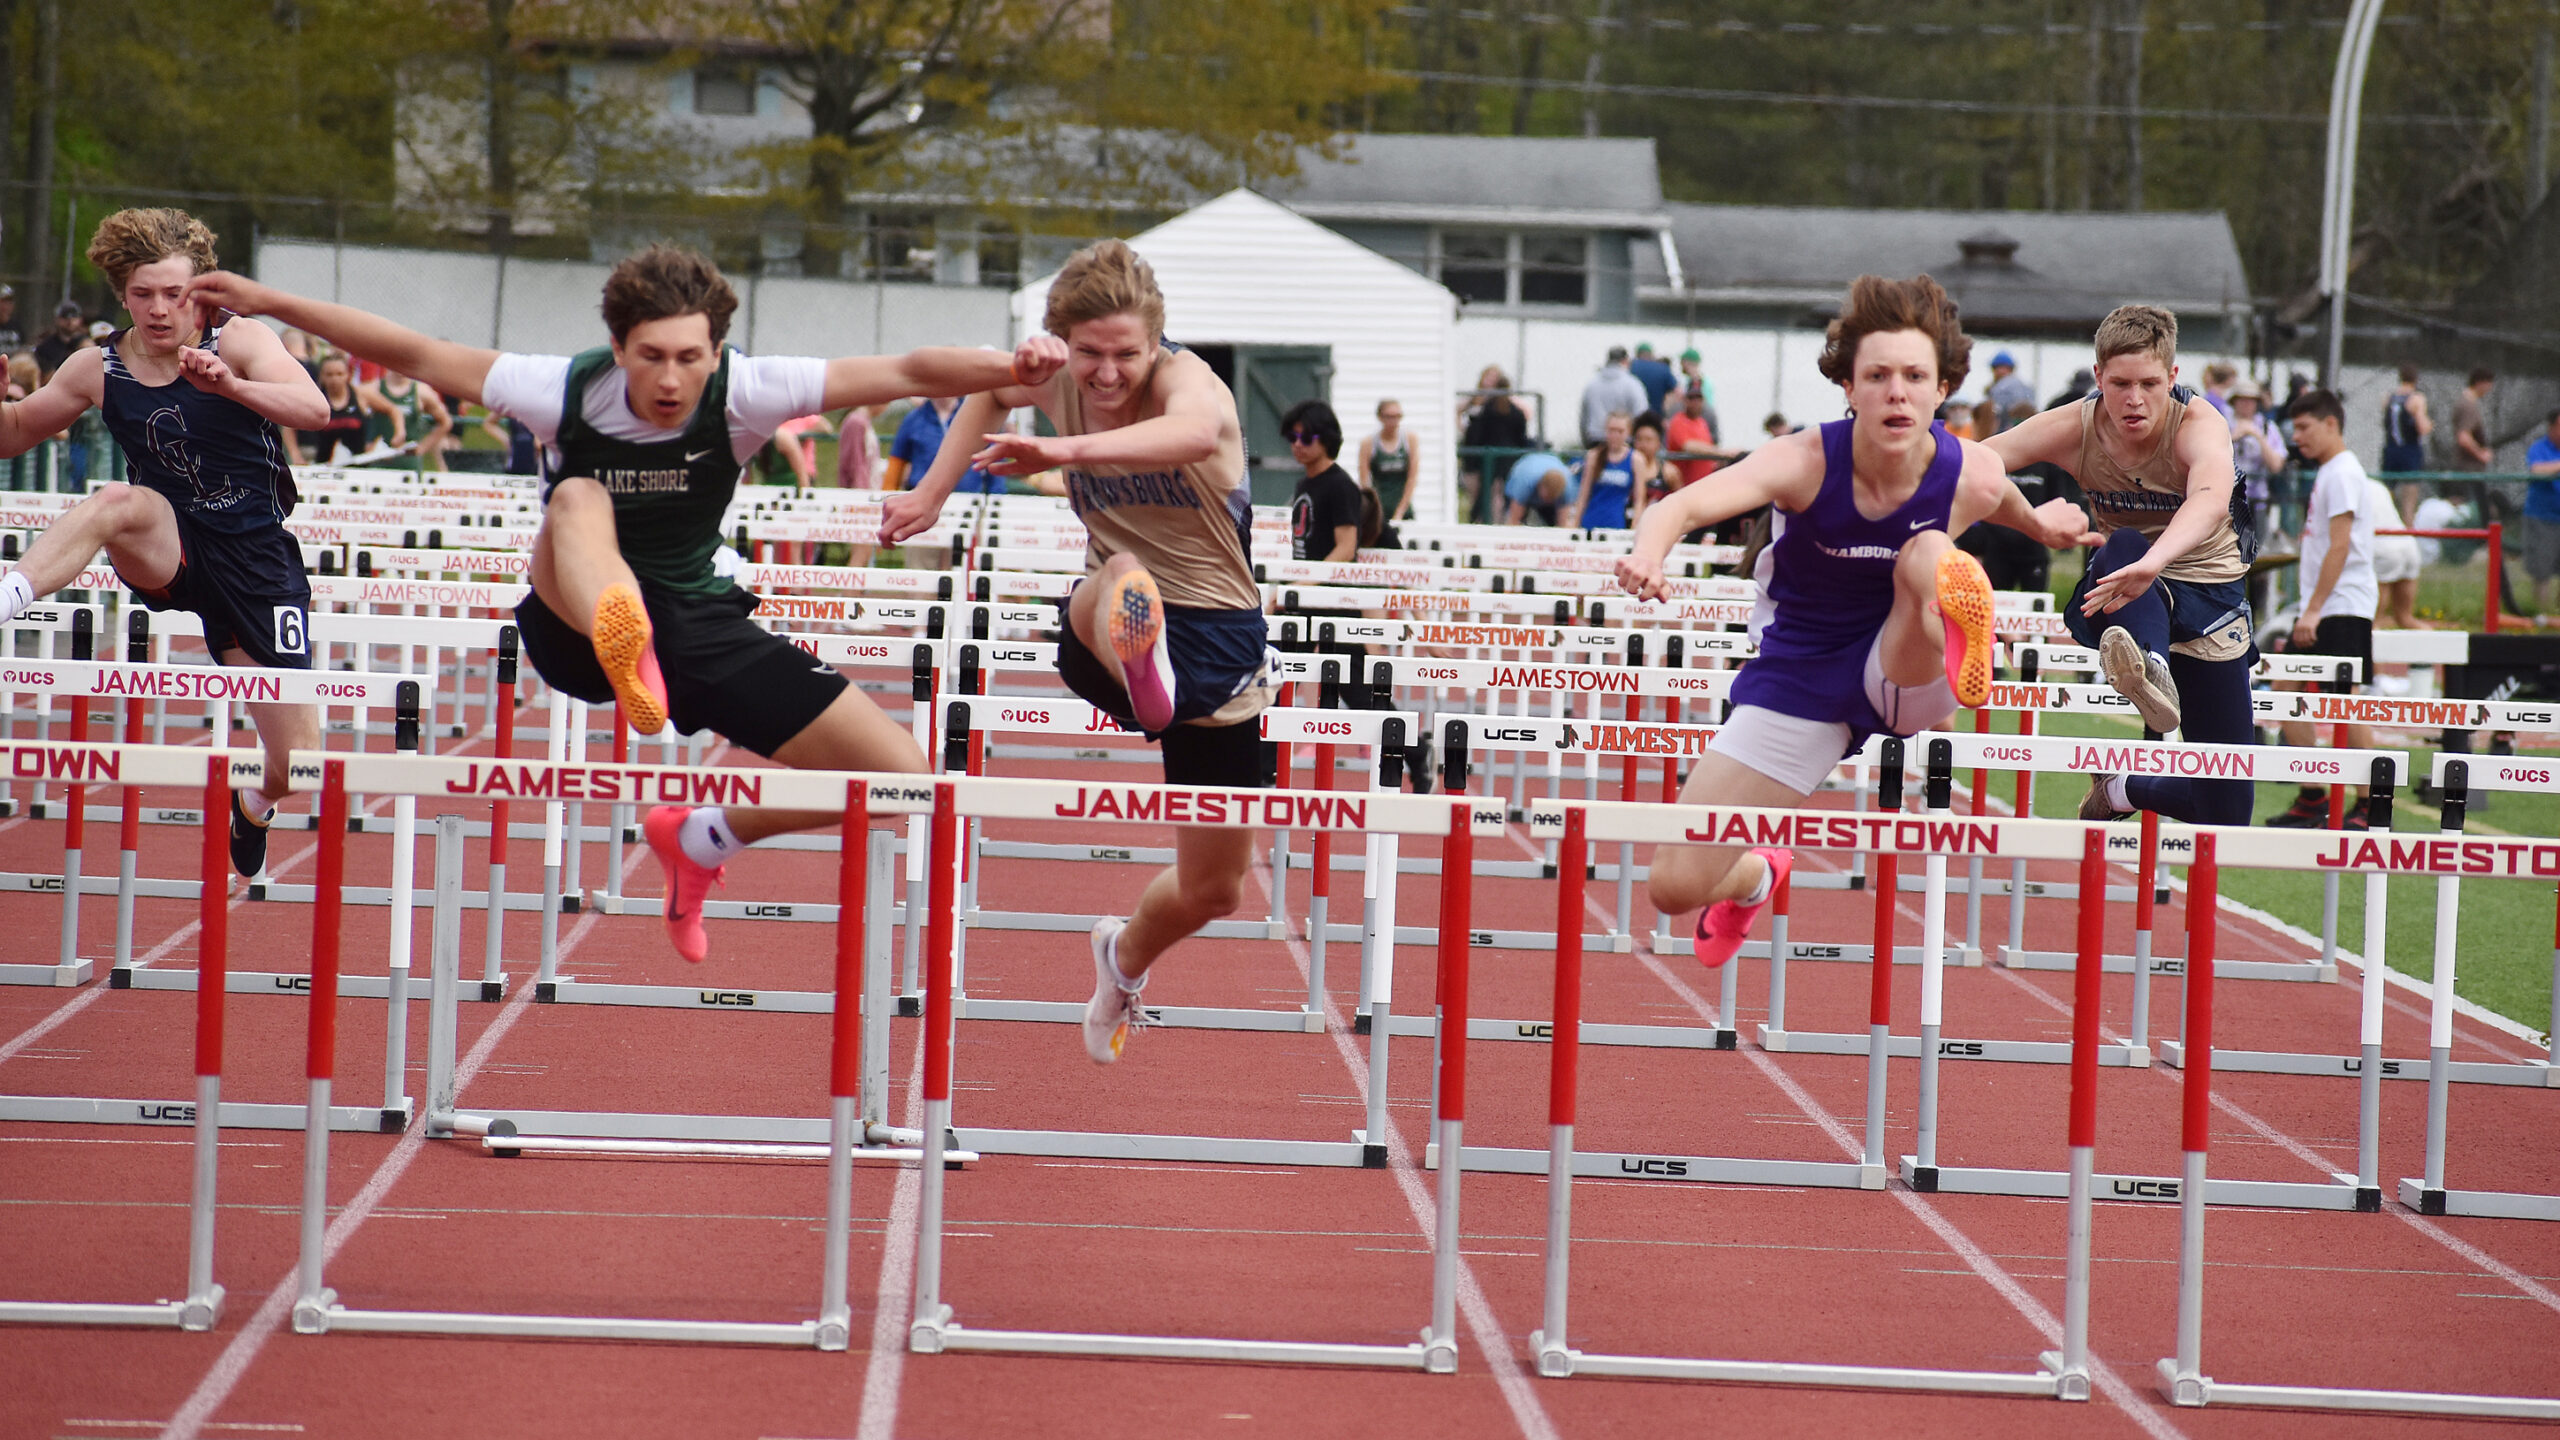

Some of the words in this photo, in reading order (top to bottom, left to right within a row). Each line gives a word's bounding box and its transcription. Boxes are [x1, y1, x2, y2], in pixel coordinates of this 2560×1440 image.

[638, 469, 689, 493] SHORE
[752, 568, 866, 587] JAMESTOWN
[1329, 567, 1430, 585] JAMESTOWN
[359, 583, 491, 605] JAMESTOWN
[1383, 594, 1470, 610] JAMESTOWN
[878, 608, 916, 618] UCS
[1001, 611, 1038, 621] UCS
[281, 610, 301, 650] 6
[1347, 627, 1384, 636] UCS
[1417, 625, 1545, 647] JAMESTOWN
[1578, 635, 1616, 645] UCS
[858, 646, 888, 657] UCS
[1695, 640, 1733, 649] UCS
[992, 650, 1036, 662] UCS
[2050, 655, 2088, 663] UCS
[1284, 662, 1307, 673] CS
[2285, 664, 2323, 674] UCS
[19, 672, 55, 685] UCS
[91, 670, 280, 701] JAMESTOWN
[331, 685, 366, 698] UCS
[1430, 669, 1458, 679] UCS
[1487, 667, 1639, 693] JAMESTOWN
[1680, 679, 1708, 690] UCS
[2087, 694, 2131, 706] UCS
[1015, 710, 1050, 723] UCS
[2312, 697, 2468, 726] JAMESTOWN
[2506, 712, 2552, 723] UCS
[1317, 722, 1351, 735] UCS
[1484, 728, 1537, 741] UCS
[0, 747, 120, 781] OWN
[1998, 748, 2032, 761] UCS
[2067, 746, 2254, 777] JAMESTOWN
[2304, 761, 2340, 775] UCS
[2515, 769, 2550, 783] UCS
[447, 764, 761, 805] JAMESTOWN
[1056, 787, 1366, 829] JAMESTOWN
[1686, 812, 1998, 854] JAMESTOWN
[1091, 849, 1130, 859] UCS
[2317, 838, 2560, 877] JAMESTO
[745, 906, 791, 917] UCS
[1470, 933, 1493, 944] CS
[1794, 947, 1841, 957] UCS
[275, 977, 311, 990] UC
[700, 992, 754, 1006] UCS
[1518, 1025, 1553, 1037] UC
[2343, 1060, 2400, 1074] US
[1621, 1159, 1687, 1176] UCS
[2114, 1181, 2180, 1197] UCS
